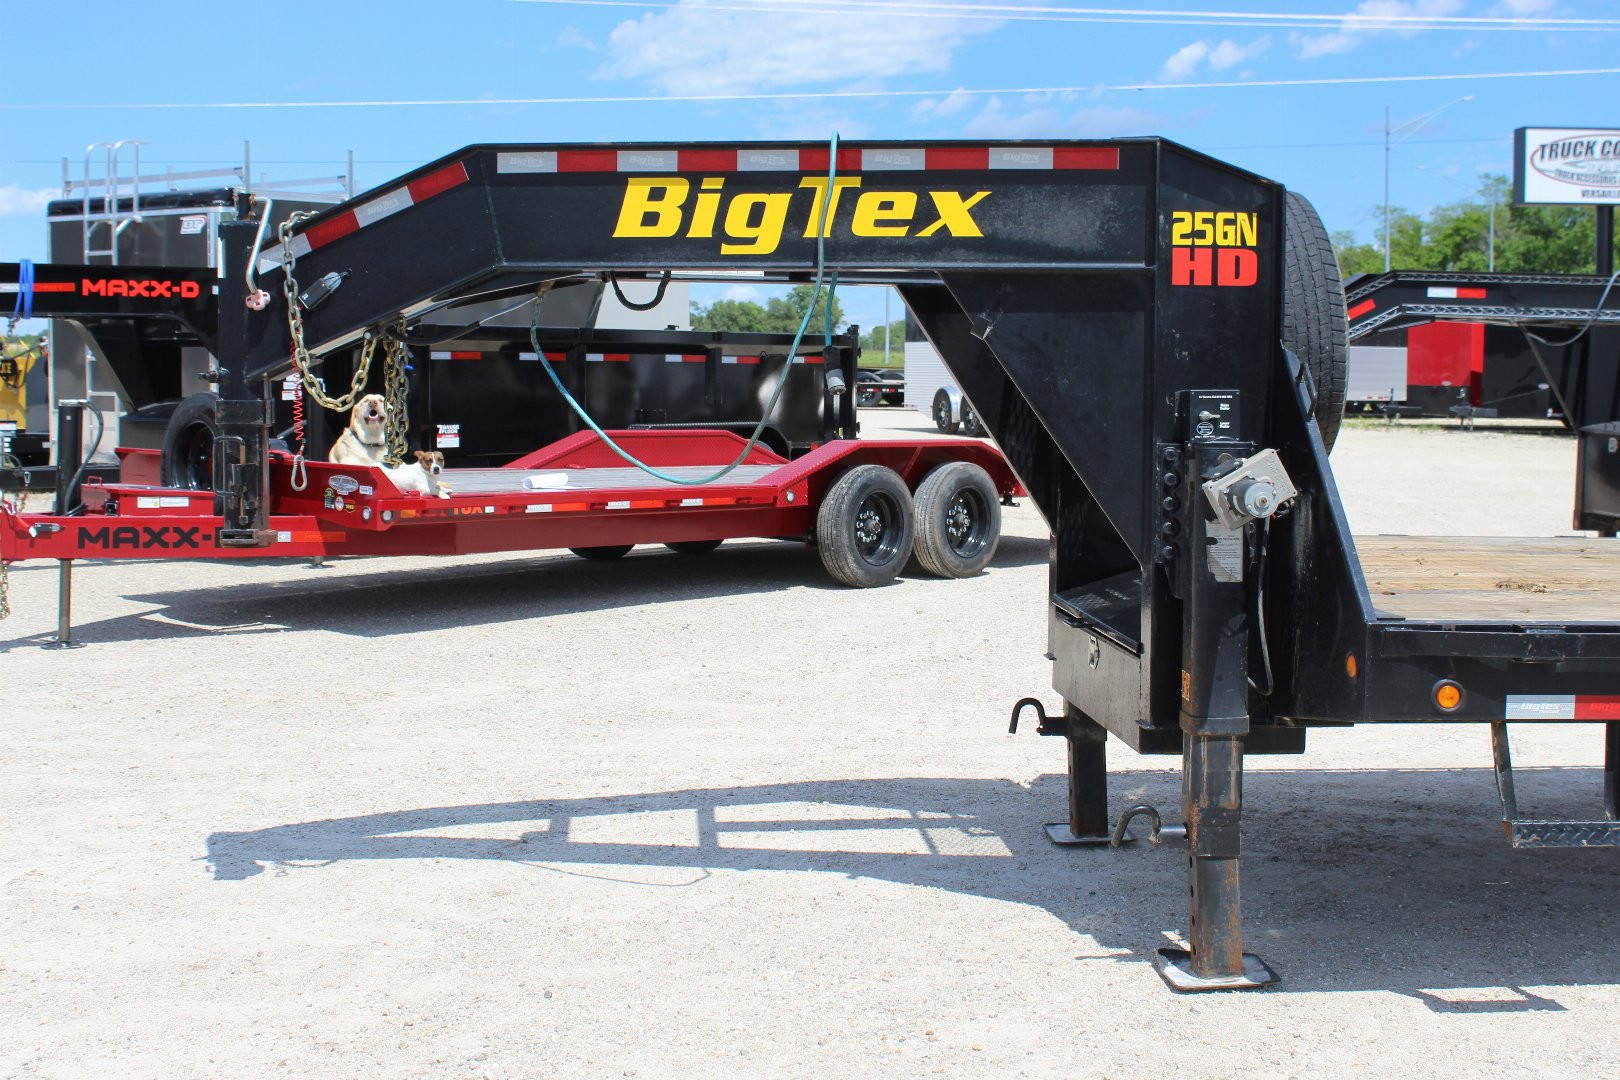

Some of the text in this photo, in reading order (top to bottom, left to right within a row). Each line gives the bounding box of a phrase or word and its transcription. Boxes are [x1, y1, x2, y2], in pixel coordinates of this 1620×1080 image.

[1540, 140, 1597, 161] TRUCK
[612, 176, 993, 255] BigTex
[1171, 211, 1258, 247] 25GN
[1171, 247, 1258, 287] HD
[82, 278, 200, 299] MAXX-D
[77, 526, 223, 549] MAXX-
